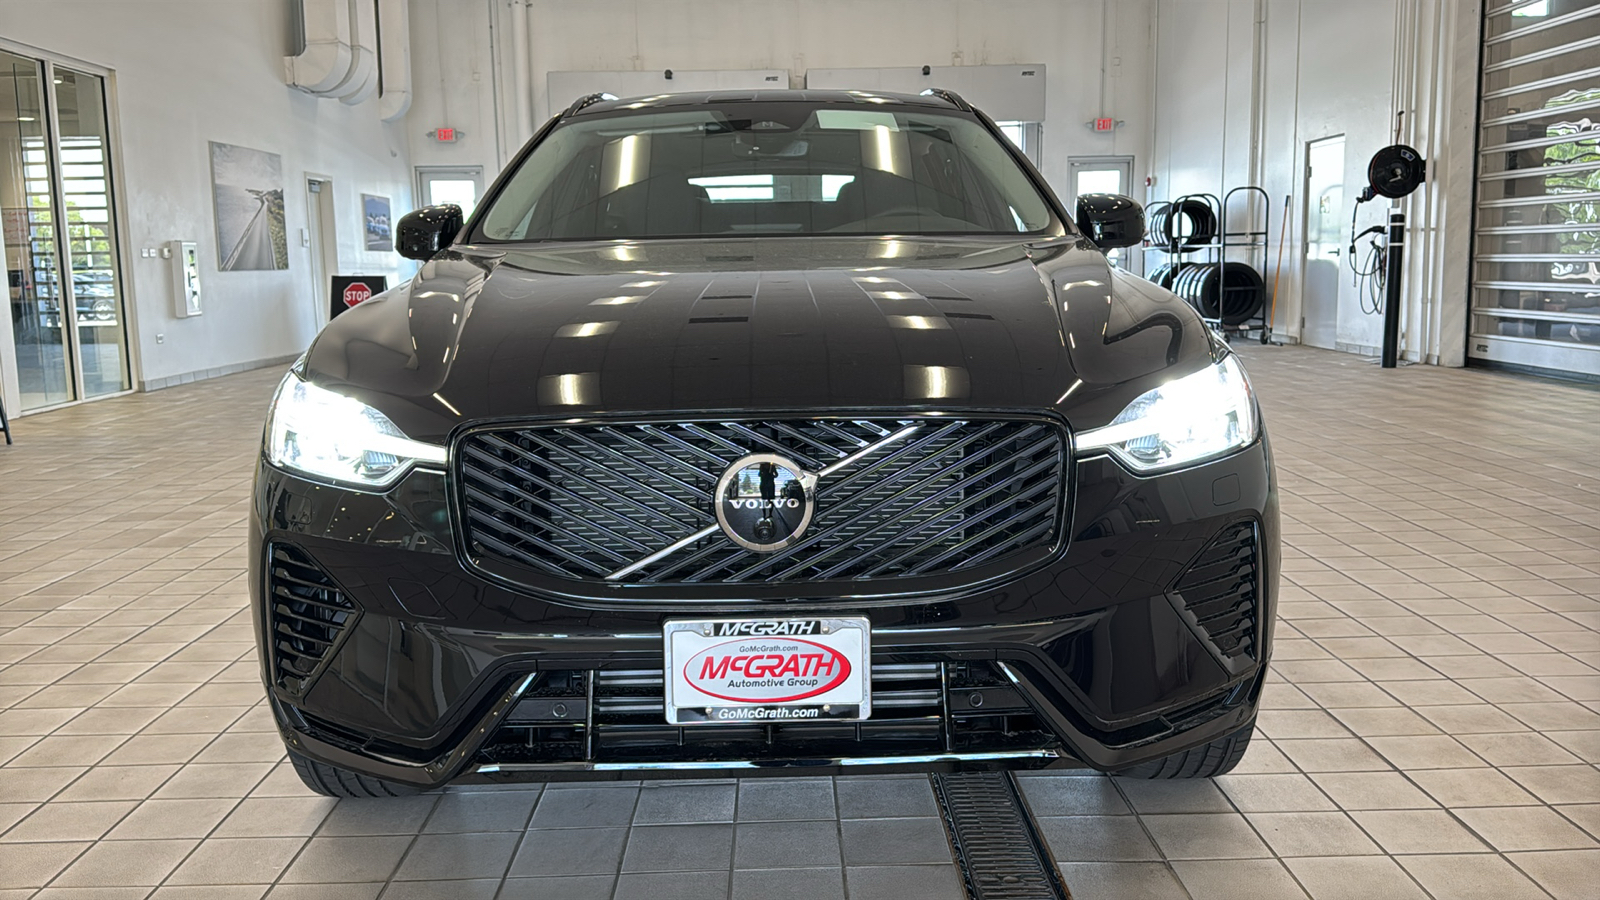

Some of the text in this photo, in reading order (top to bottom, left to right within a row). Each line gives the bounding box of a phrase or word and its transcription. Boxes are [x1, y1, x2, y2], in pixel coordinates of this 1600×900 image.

[345, 290, 370, 302] STOP
[729, 498, 799, 509] VOLVO
[739, 645, 799, 653] GoMcGrath.com
[727, 678, 818, 688] Automotive Group
[718, 708, 819, 720] GoMcGrath.com
